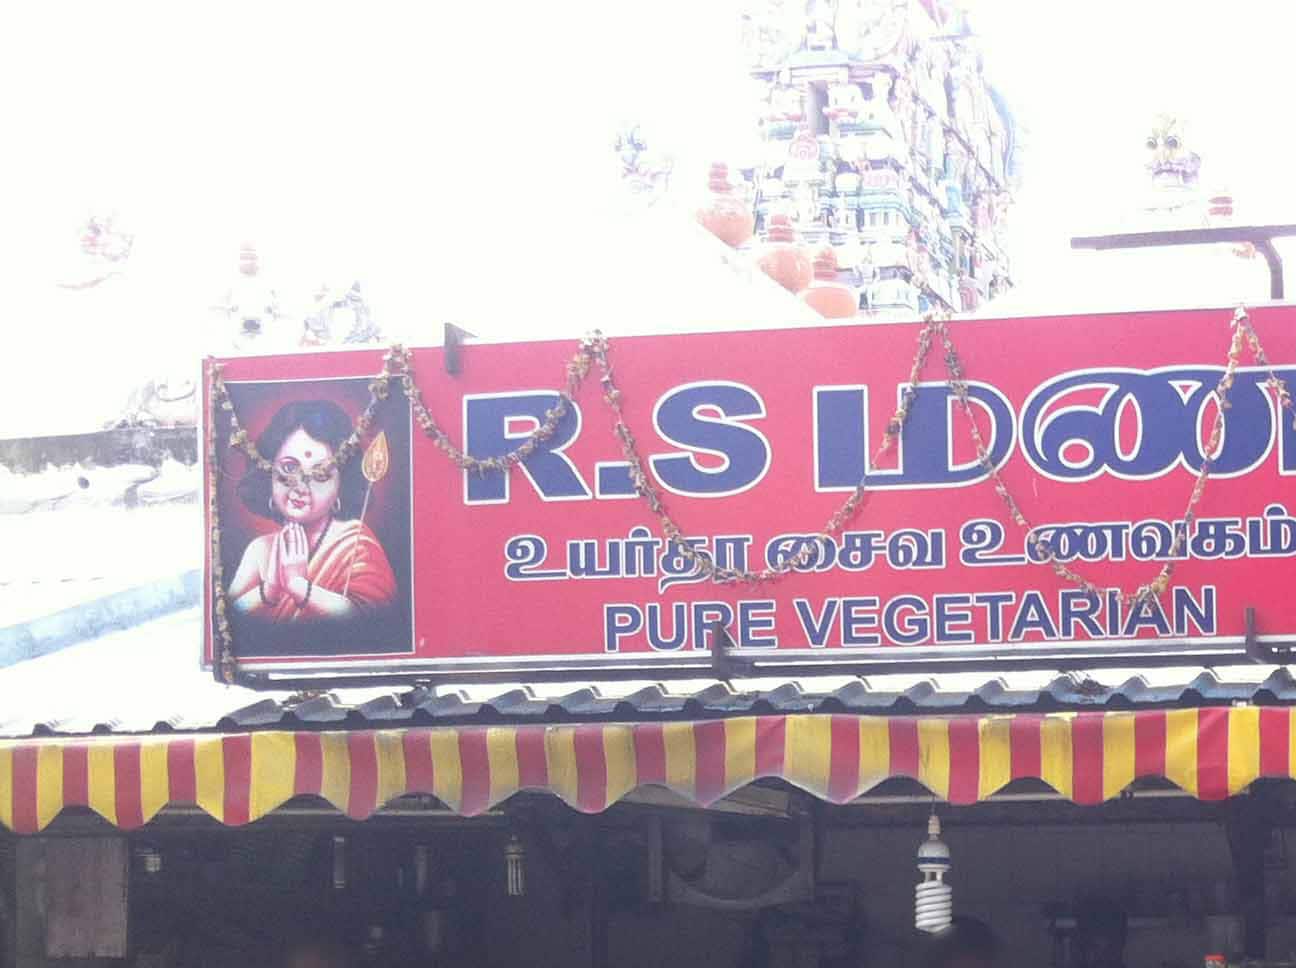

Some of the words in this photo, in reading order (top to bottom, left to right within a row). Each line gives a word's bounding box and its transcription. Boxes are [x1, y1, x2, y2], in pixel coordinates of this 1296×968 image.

[765, 528, 947, 574] சைவ
[603, 599, 780, 653] PURE
[793, 584, 1217, 649] VEGETARIAN
